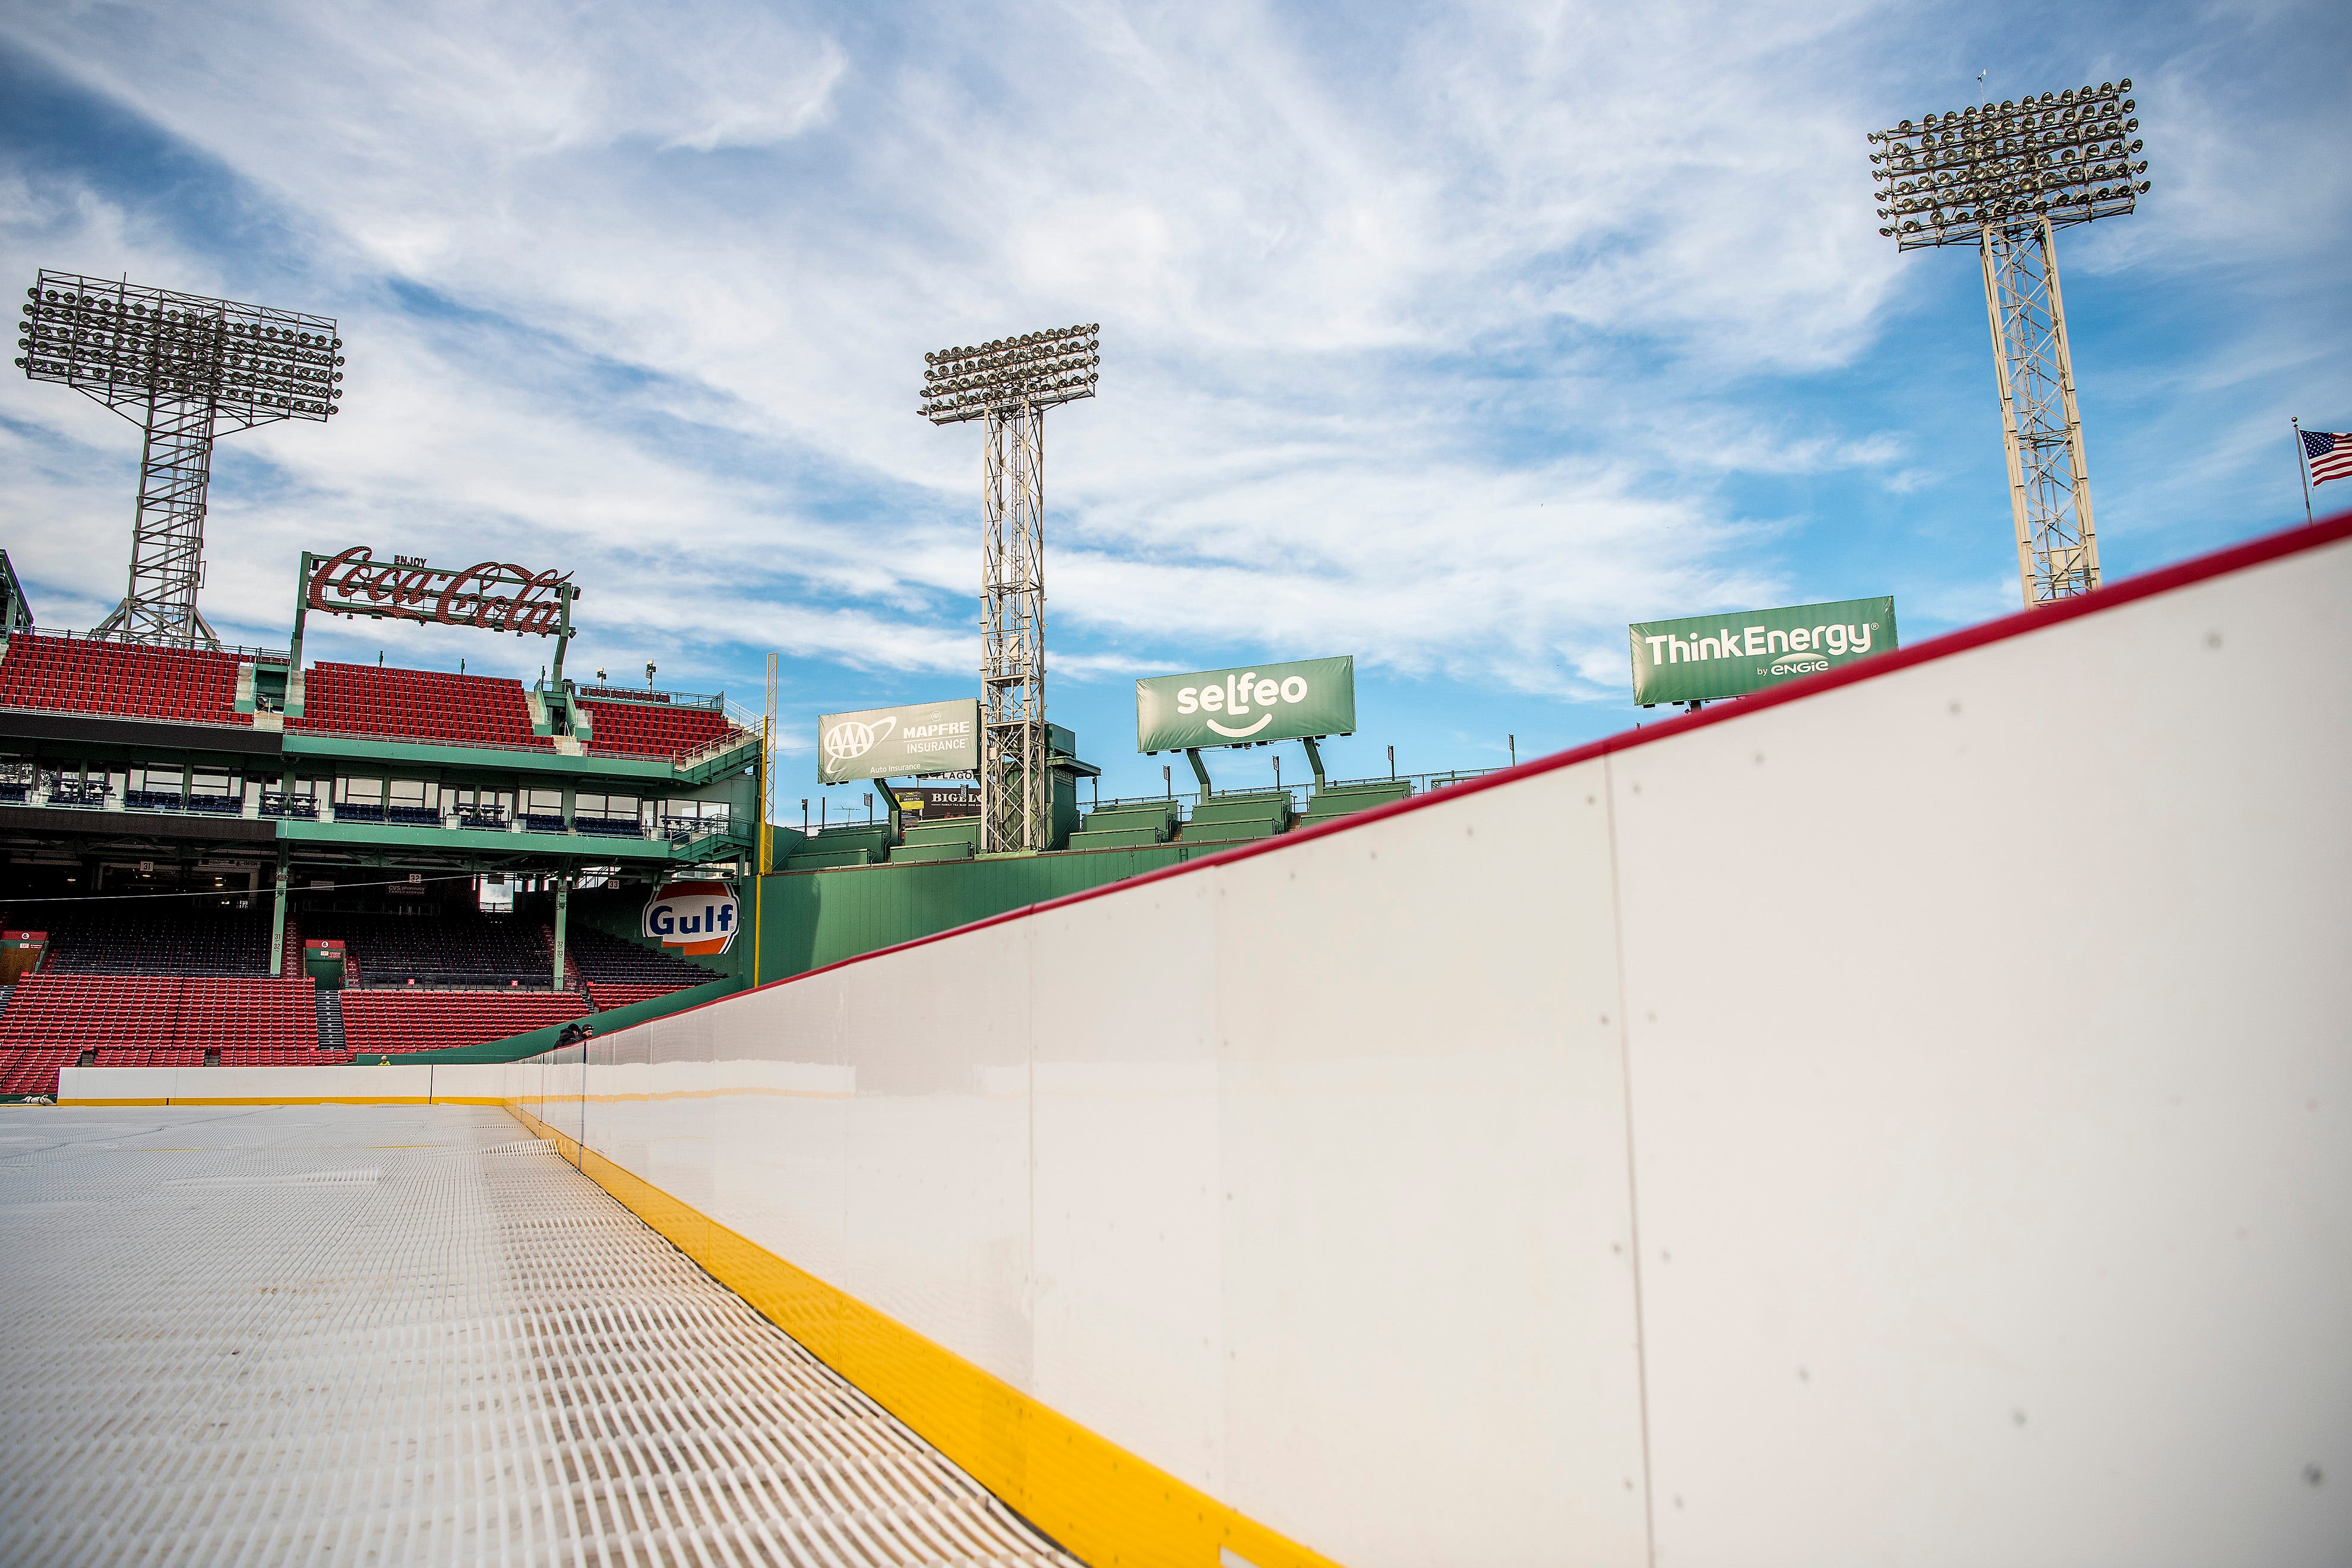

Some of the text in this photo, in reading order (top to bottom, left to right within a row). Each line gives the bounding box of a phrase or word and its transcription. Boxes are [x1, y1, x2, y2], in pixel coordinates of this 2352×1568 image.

[394, 555, 428, 568] ENJOY
[309, 546, 575, 634] Coca-Cola
[1645, 622, 1872, 666] ThinkEnergy
[1757, 667, 1768, 676] by
[903, 720, 970, 739] MAPFRE
[830, 724, 868, 757] AAA
[907, 738, 966, 754] INSURANCE
[870, 763, 921, 774] Auto Insurance
[650, 905, 734, 935] Gulf
